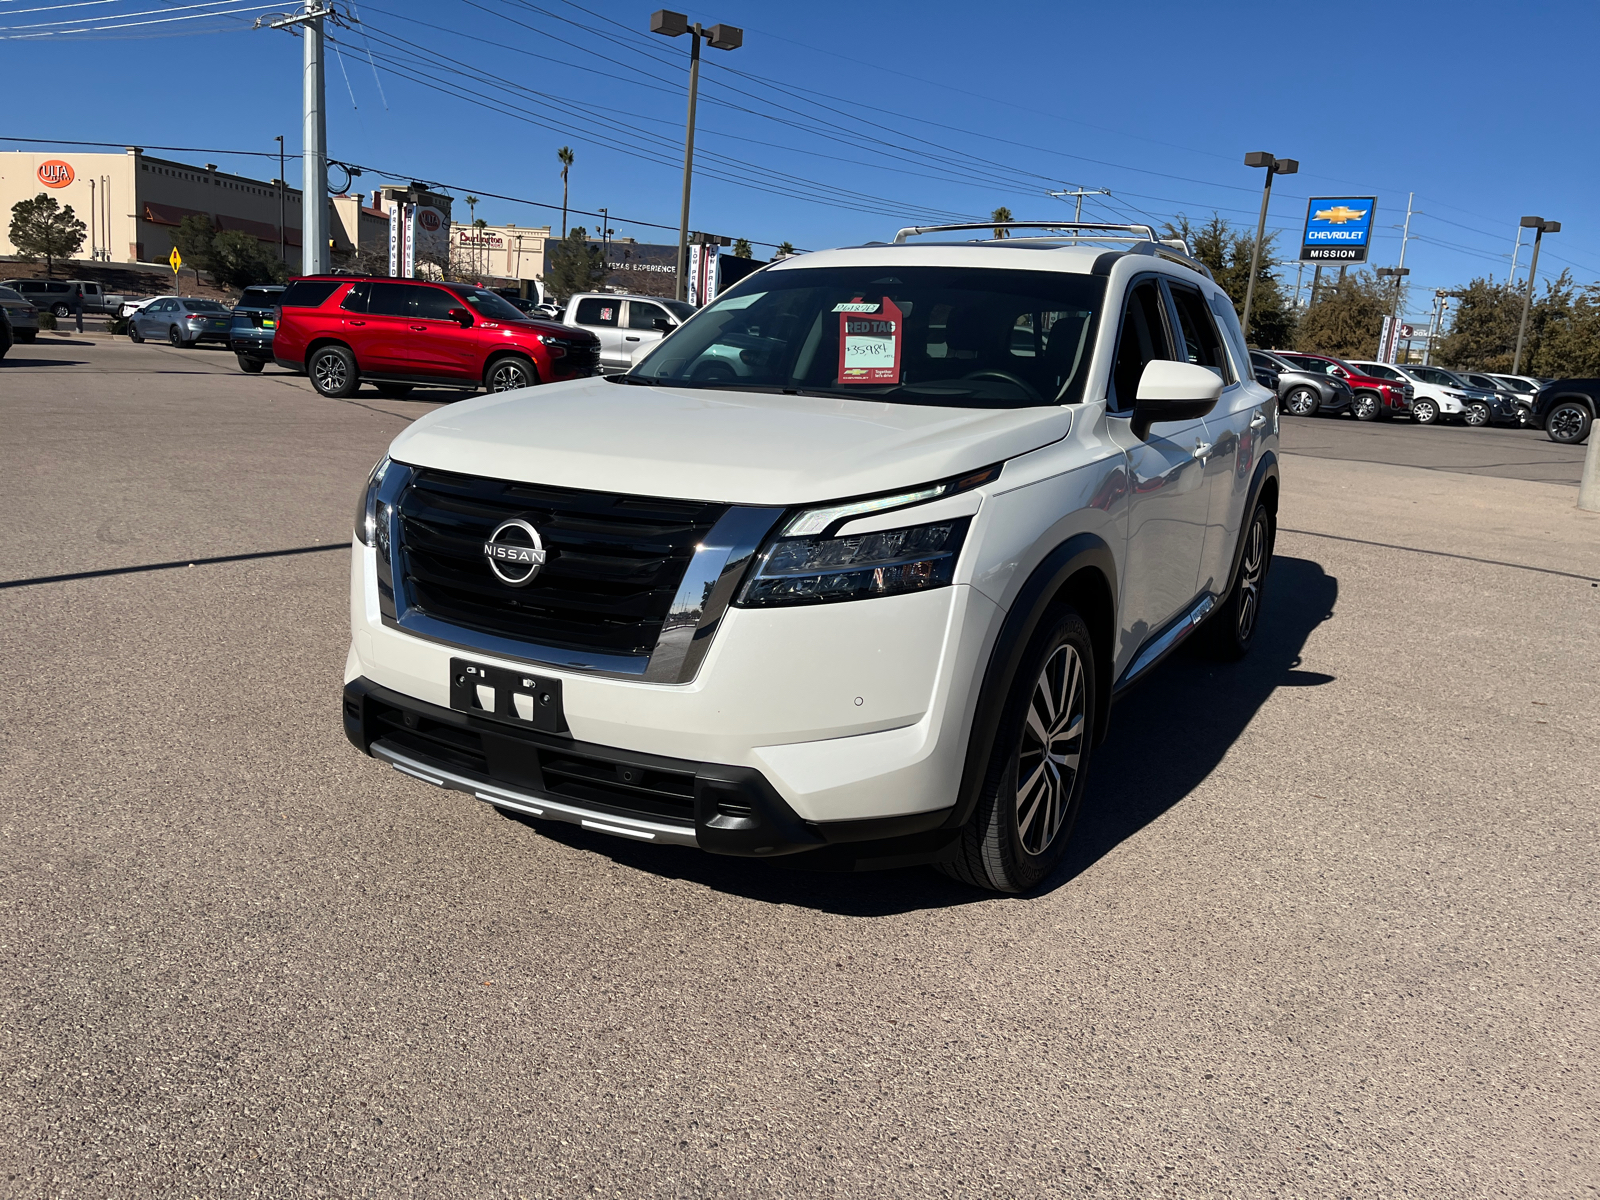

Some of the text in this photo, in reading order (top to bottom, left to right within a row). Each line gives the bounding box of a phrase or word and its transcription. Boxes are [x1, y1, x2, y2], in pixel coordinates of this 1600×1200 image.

[42, 165, 70, 178] ULTA
[460, 232, 503, 244] Burlngton
[1308, 231, 1364, 239] CHEVROLET
[1310, 250, 1356, 258] MISSION
[608, 262, 630, 271] TEXAS
[632, 263, 676, 273] EXPERIENCE
[845, 321, 896, 333] RED TAG
[484, 543, 545, 563] NISSAN
